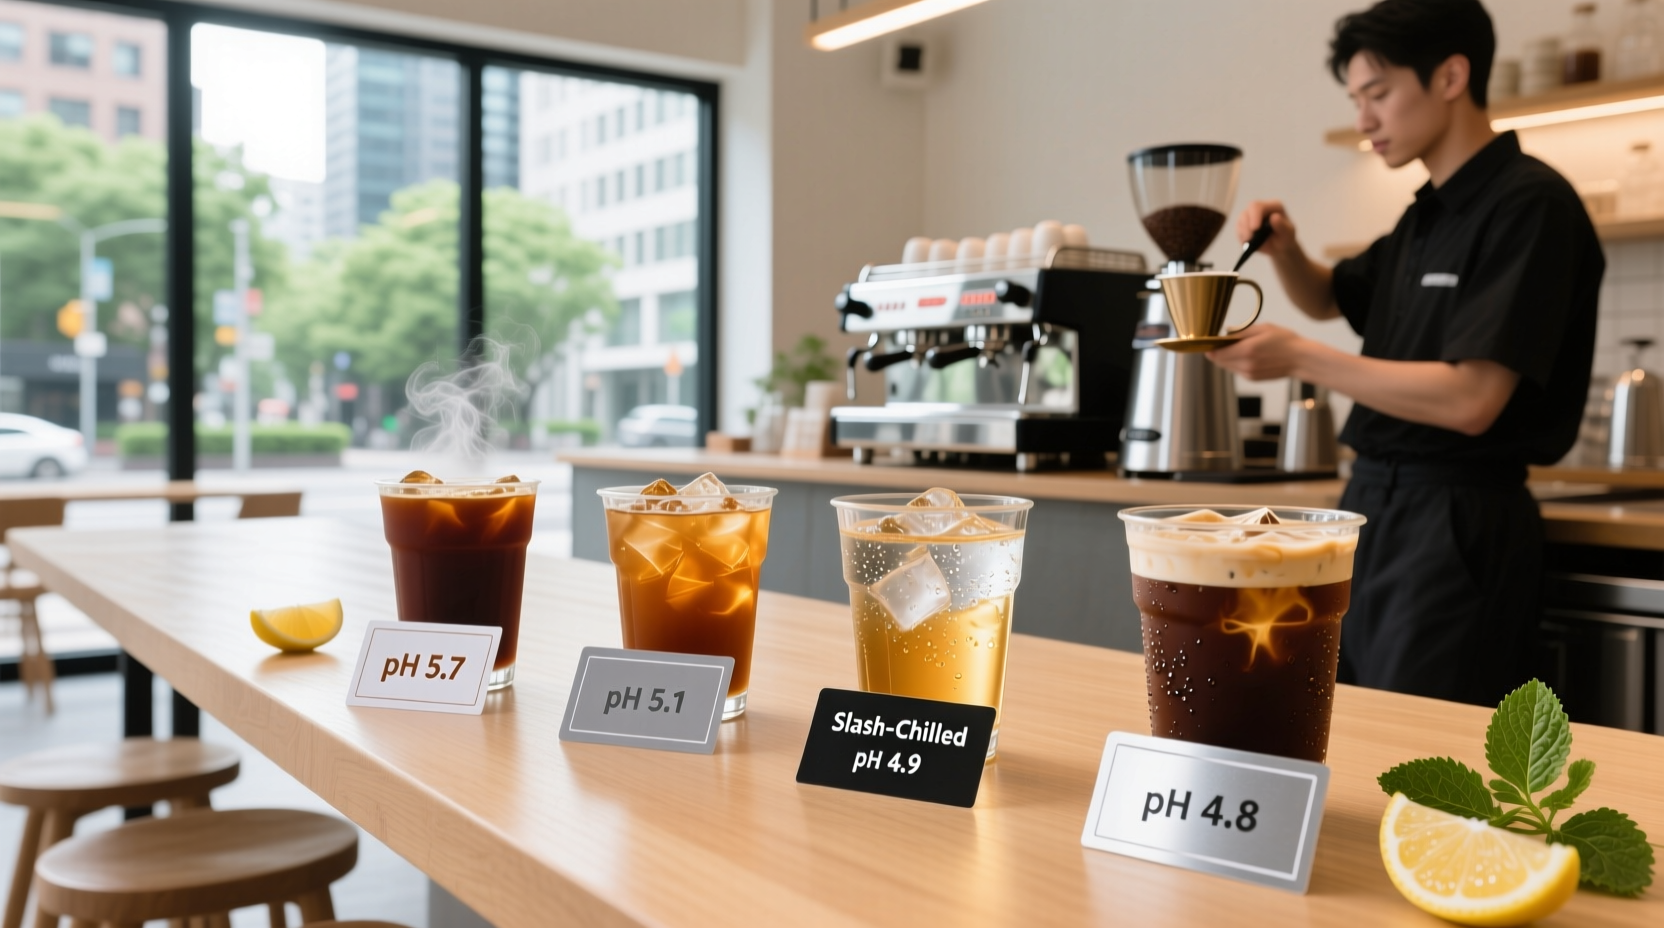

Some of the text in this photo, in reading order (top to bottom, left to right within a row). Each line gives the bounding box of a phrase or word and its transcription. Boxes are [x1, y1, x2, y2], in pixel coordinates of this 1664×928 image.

[380, 652, 466, 682] pH 5.7
[603, 686, 686, 714] pH 5.1
[831, 711, 968, 748] Slash-Chilled
[851, 749, 922, 775] pH 4.9
[1141, 789, 1260, 833] pH 4.8
